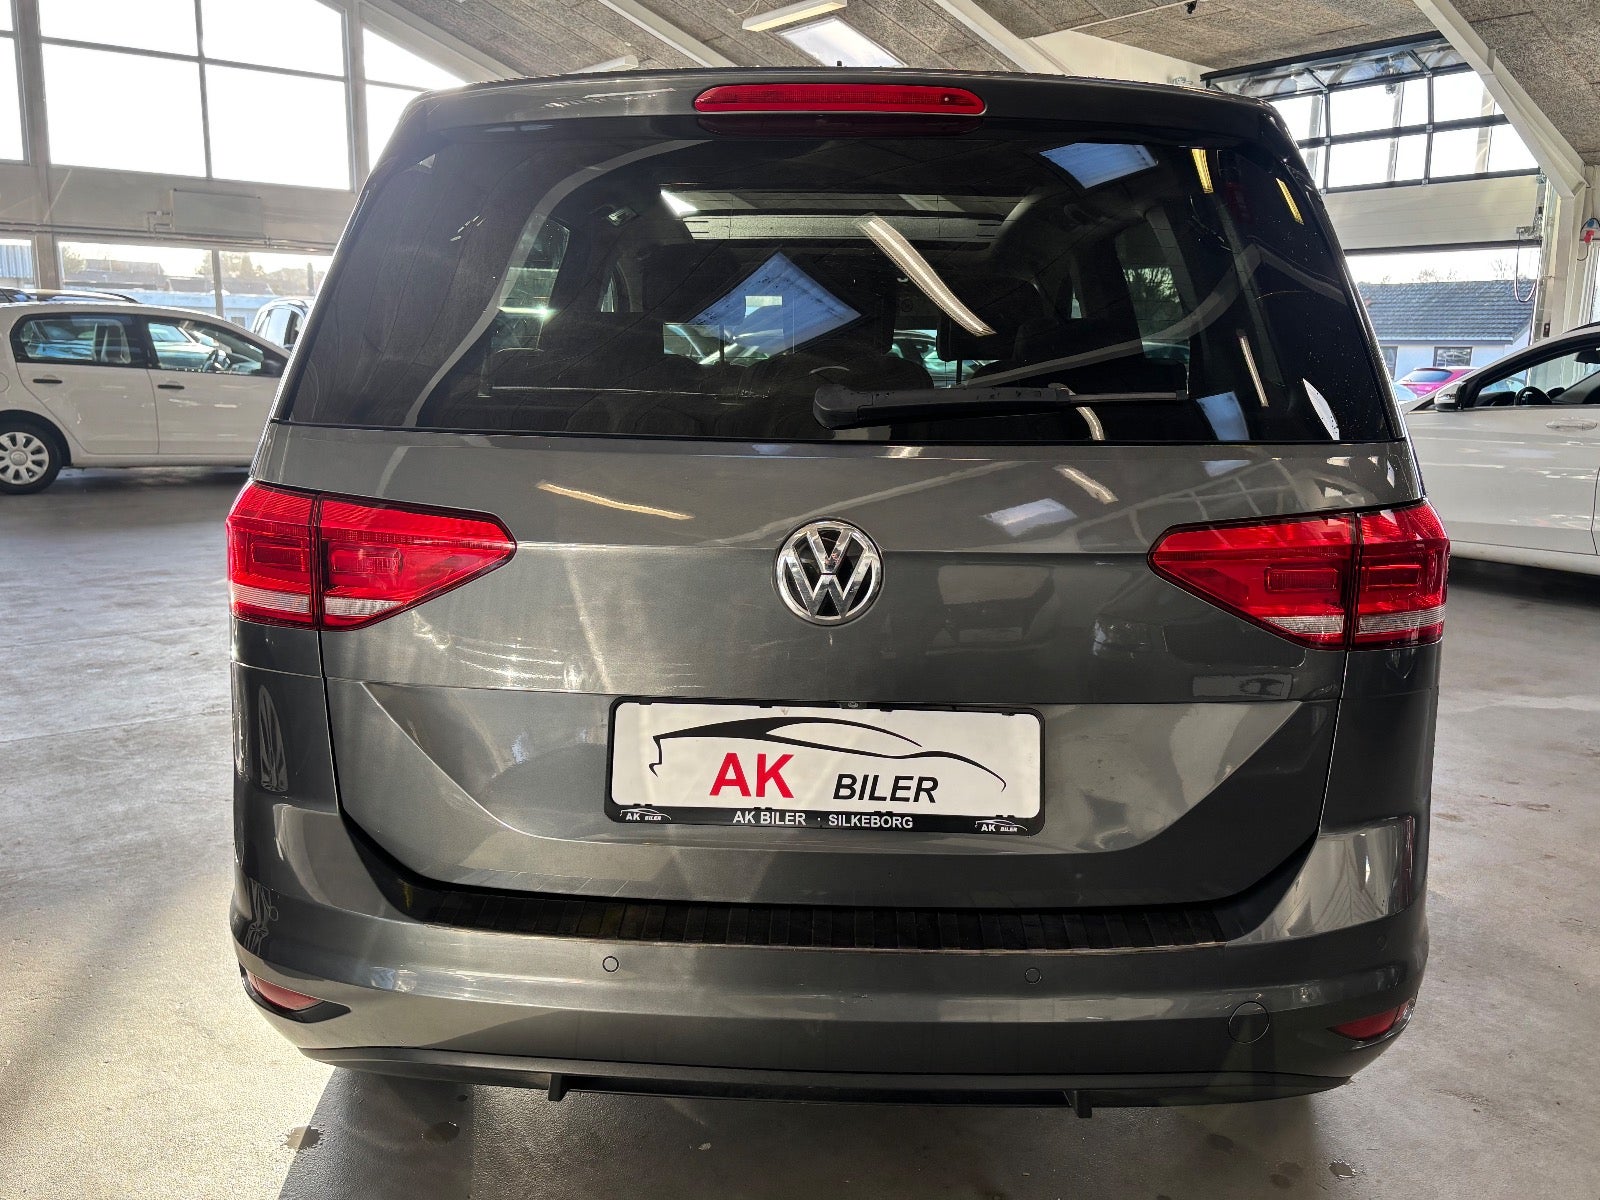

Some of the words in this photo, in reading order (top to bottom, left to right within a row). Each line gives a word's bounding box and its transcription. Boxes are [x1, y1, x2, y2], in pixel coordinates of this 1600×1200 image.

[709, 752, 795, 799] AK
[833, 773, 940, 804] BILER
[625, 812, 641, 821] AK
[732, 810, 756, 824] AK
[760, 811, 807, 826] BILER
[828, 814, 914, 829] SILKEBORG
[980, 823, 996, 832] AK
